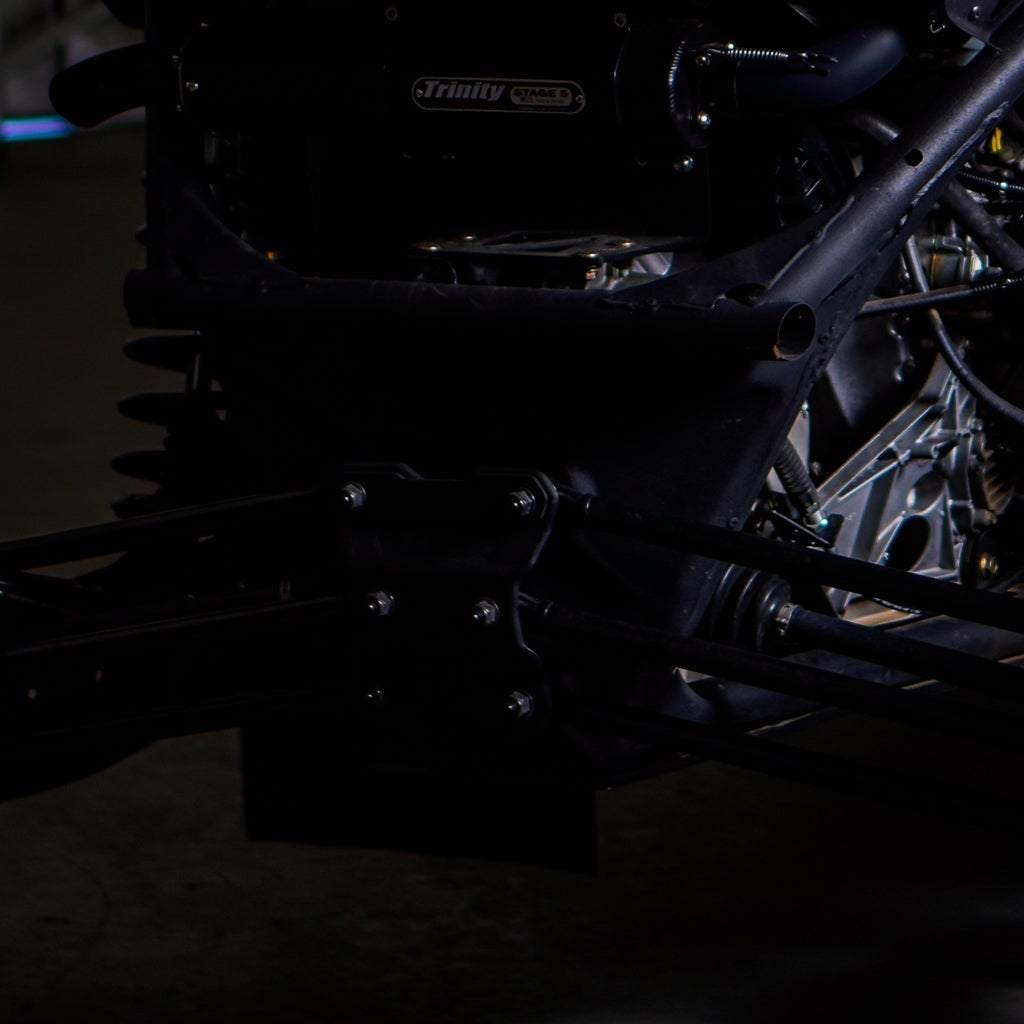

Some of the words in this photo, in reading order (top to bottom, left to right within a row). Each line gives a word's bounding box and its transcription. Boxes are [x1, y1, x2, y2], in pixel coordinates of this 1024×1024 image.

[424, 81, 506, 102] Trinity
[513, 88, 557, 97] STAGE
[560, 88, 569, 98] 5
